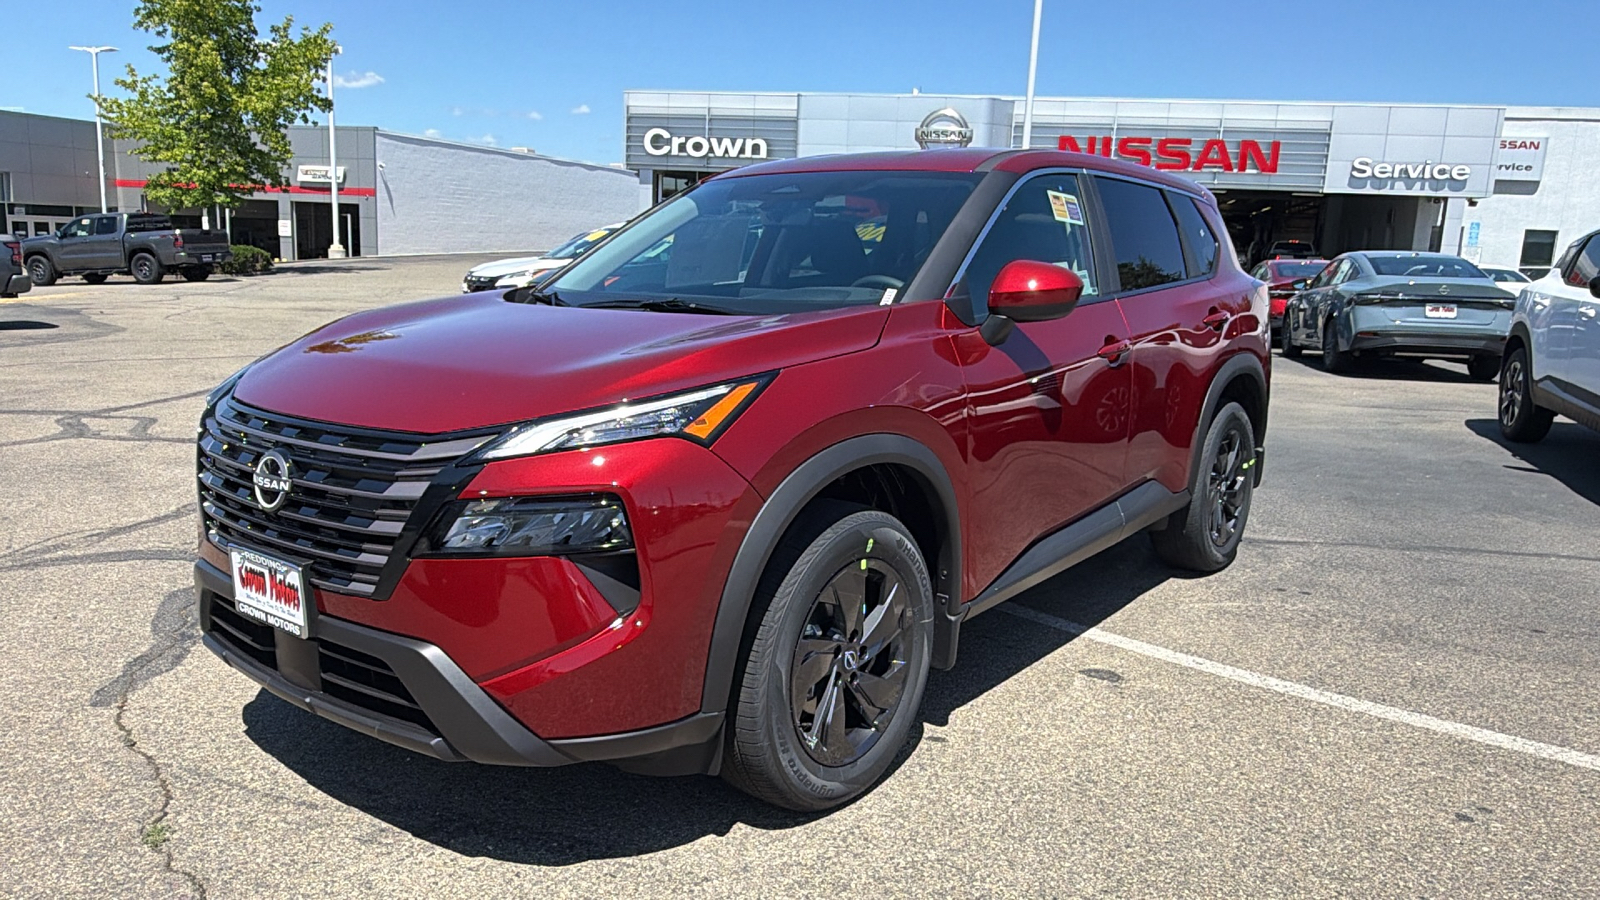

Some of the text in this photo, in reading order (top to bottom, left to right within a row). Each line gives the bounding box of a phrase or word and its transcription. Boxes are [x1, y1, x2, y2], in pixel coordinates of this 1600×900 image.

[643, 127, 768, 159] Crown
[920, 130, 967, 140] NISSAN
[1499, 140, 1540, 150] SSAN
[1058, 135, 1281, 174] NISSAN
[1351, 157, 1471, 180] Service
[1497, 162, 1533, 172] rvice
[253, 473, 289, 491] SSAN
[239, 603, 266, 622] CROWN
[267, 614, 300, 636] MOTORS
